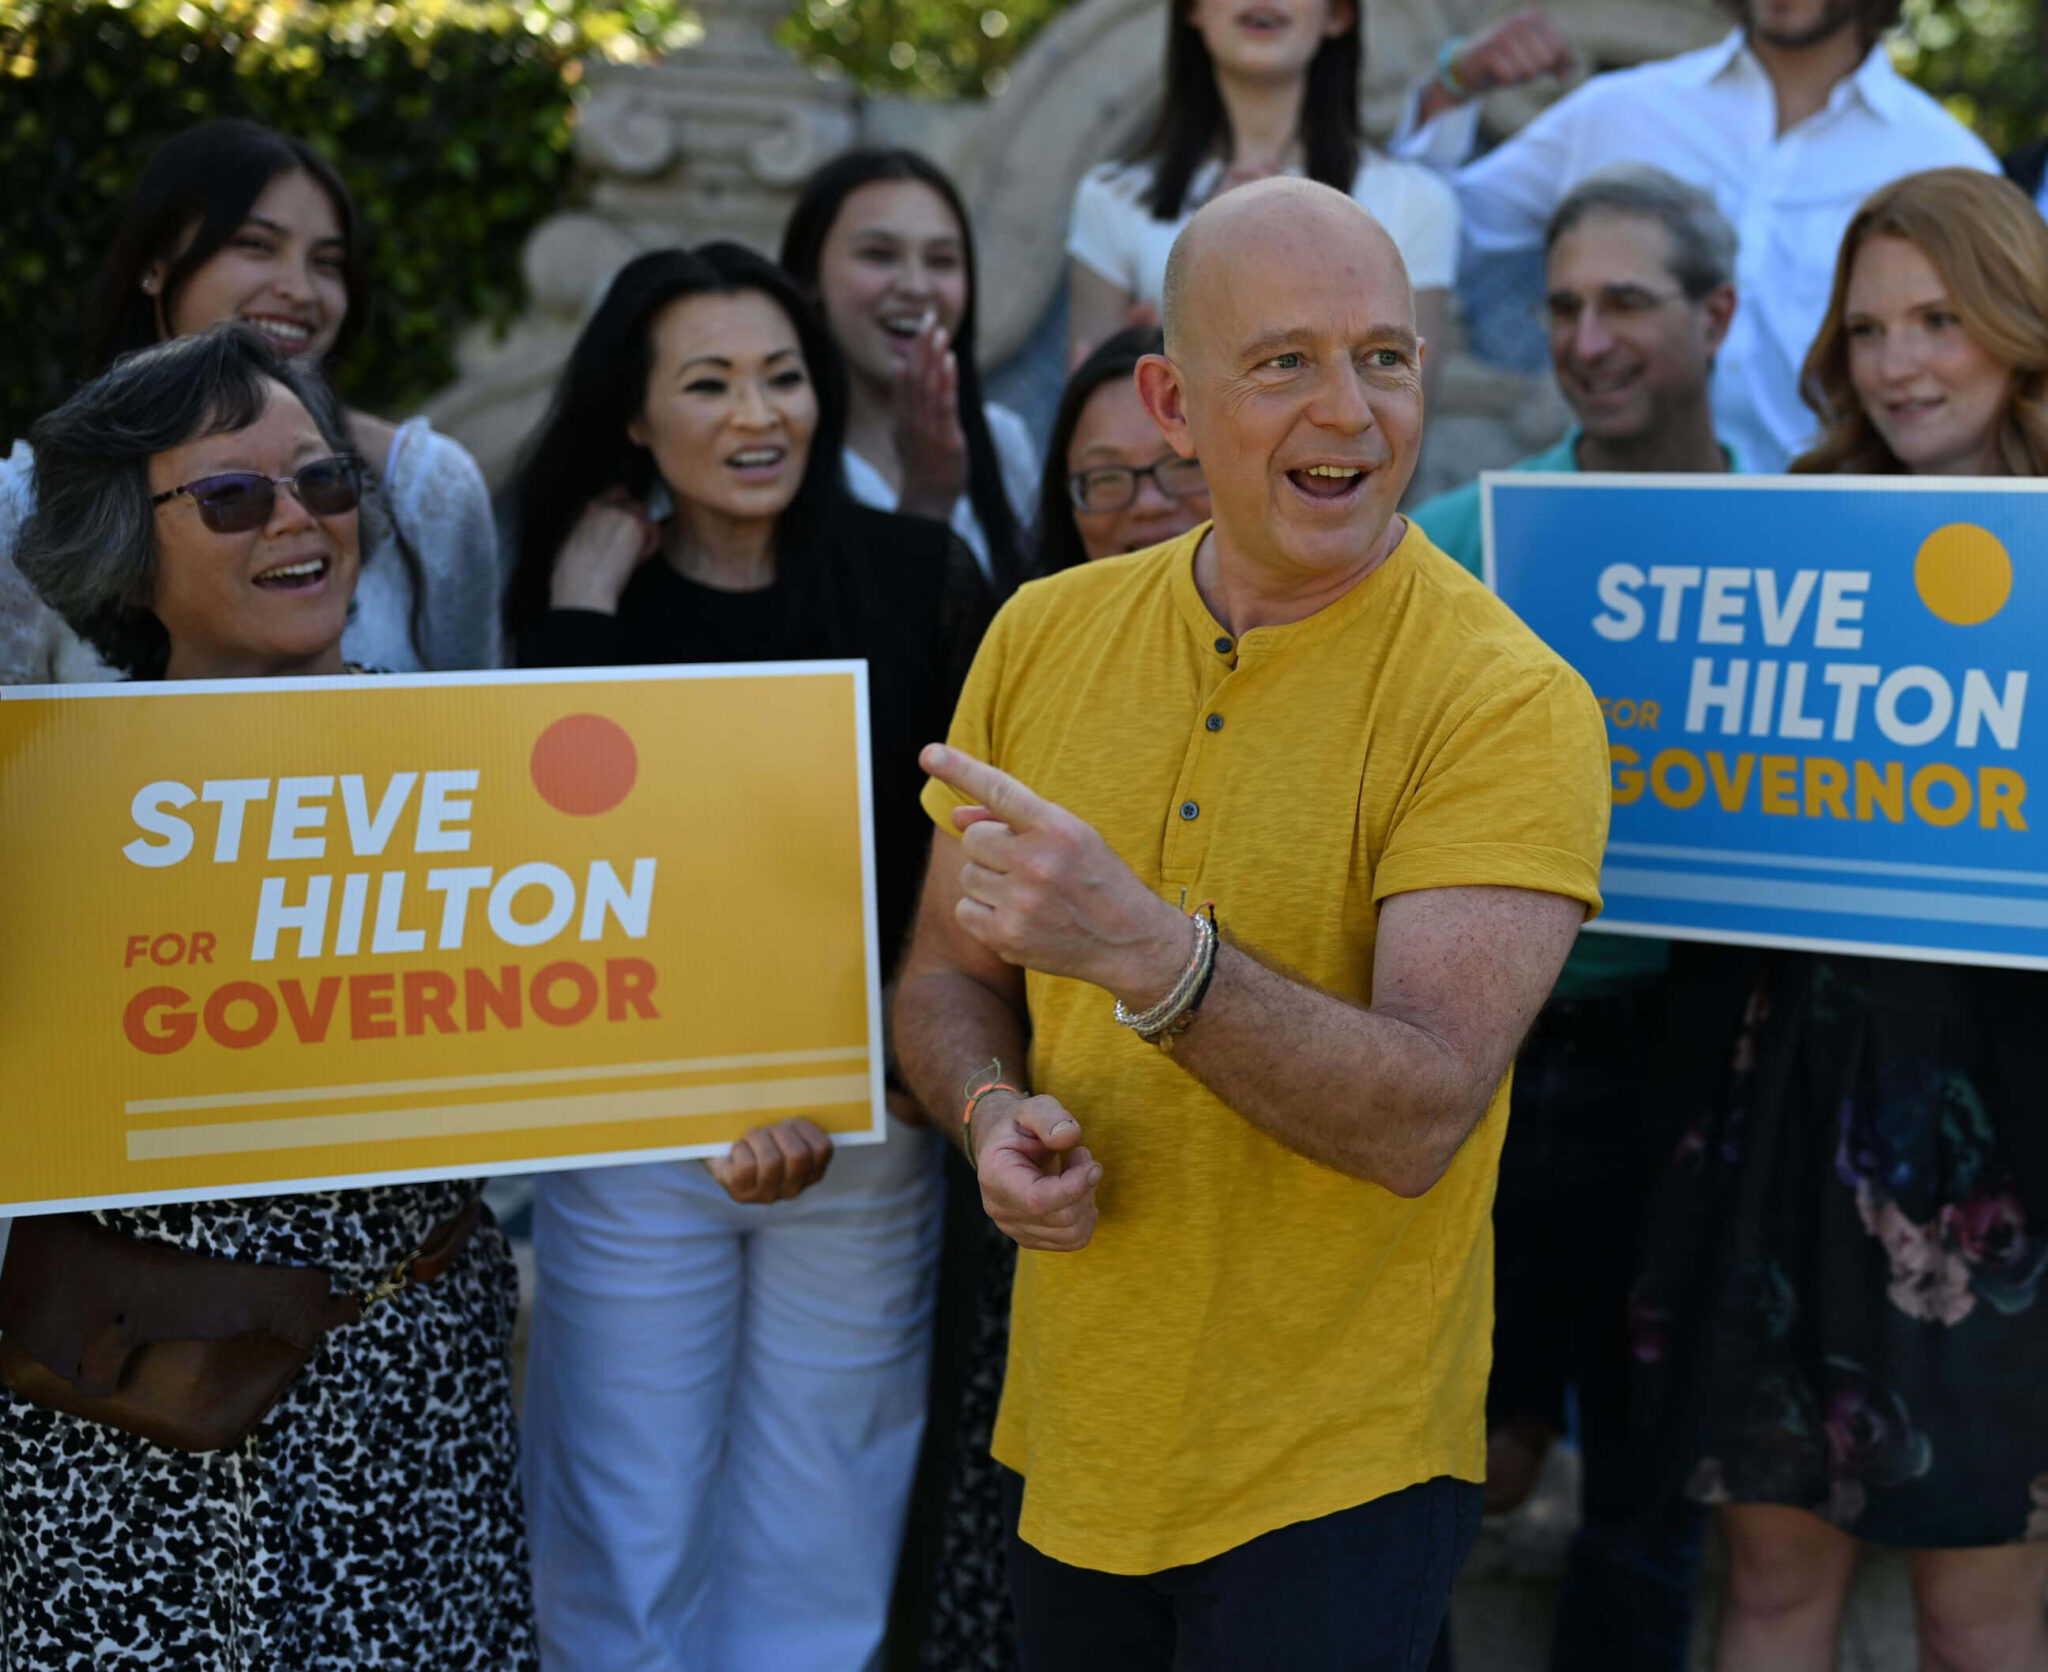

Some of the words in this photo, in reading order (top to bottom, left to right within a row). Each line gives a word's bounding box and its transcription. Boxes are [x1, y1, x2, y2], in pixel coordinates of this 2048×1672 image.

[1591, 562, 1871, 649] STEVE
[1684, 657, 2028, 750] HILTON
[121, 768, 480, 868] STEVE
[1610, 745, 2029, 831] GOVERNOR
[124, 932, 216, 969] FOR
[251, 857, 657, 961] HILTON
[122, 957, 661, 1056] GOVERNOR
